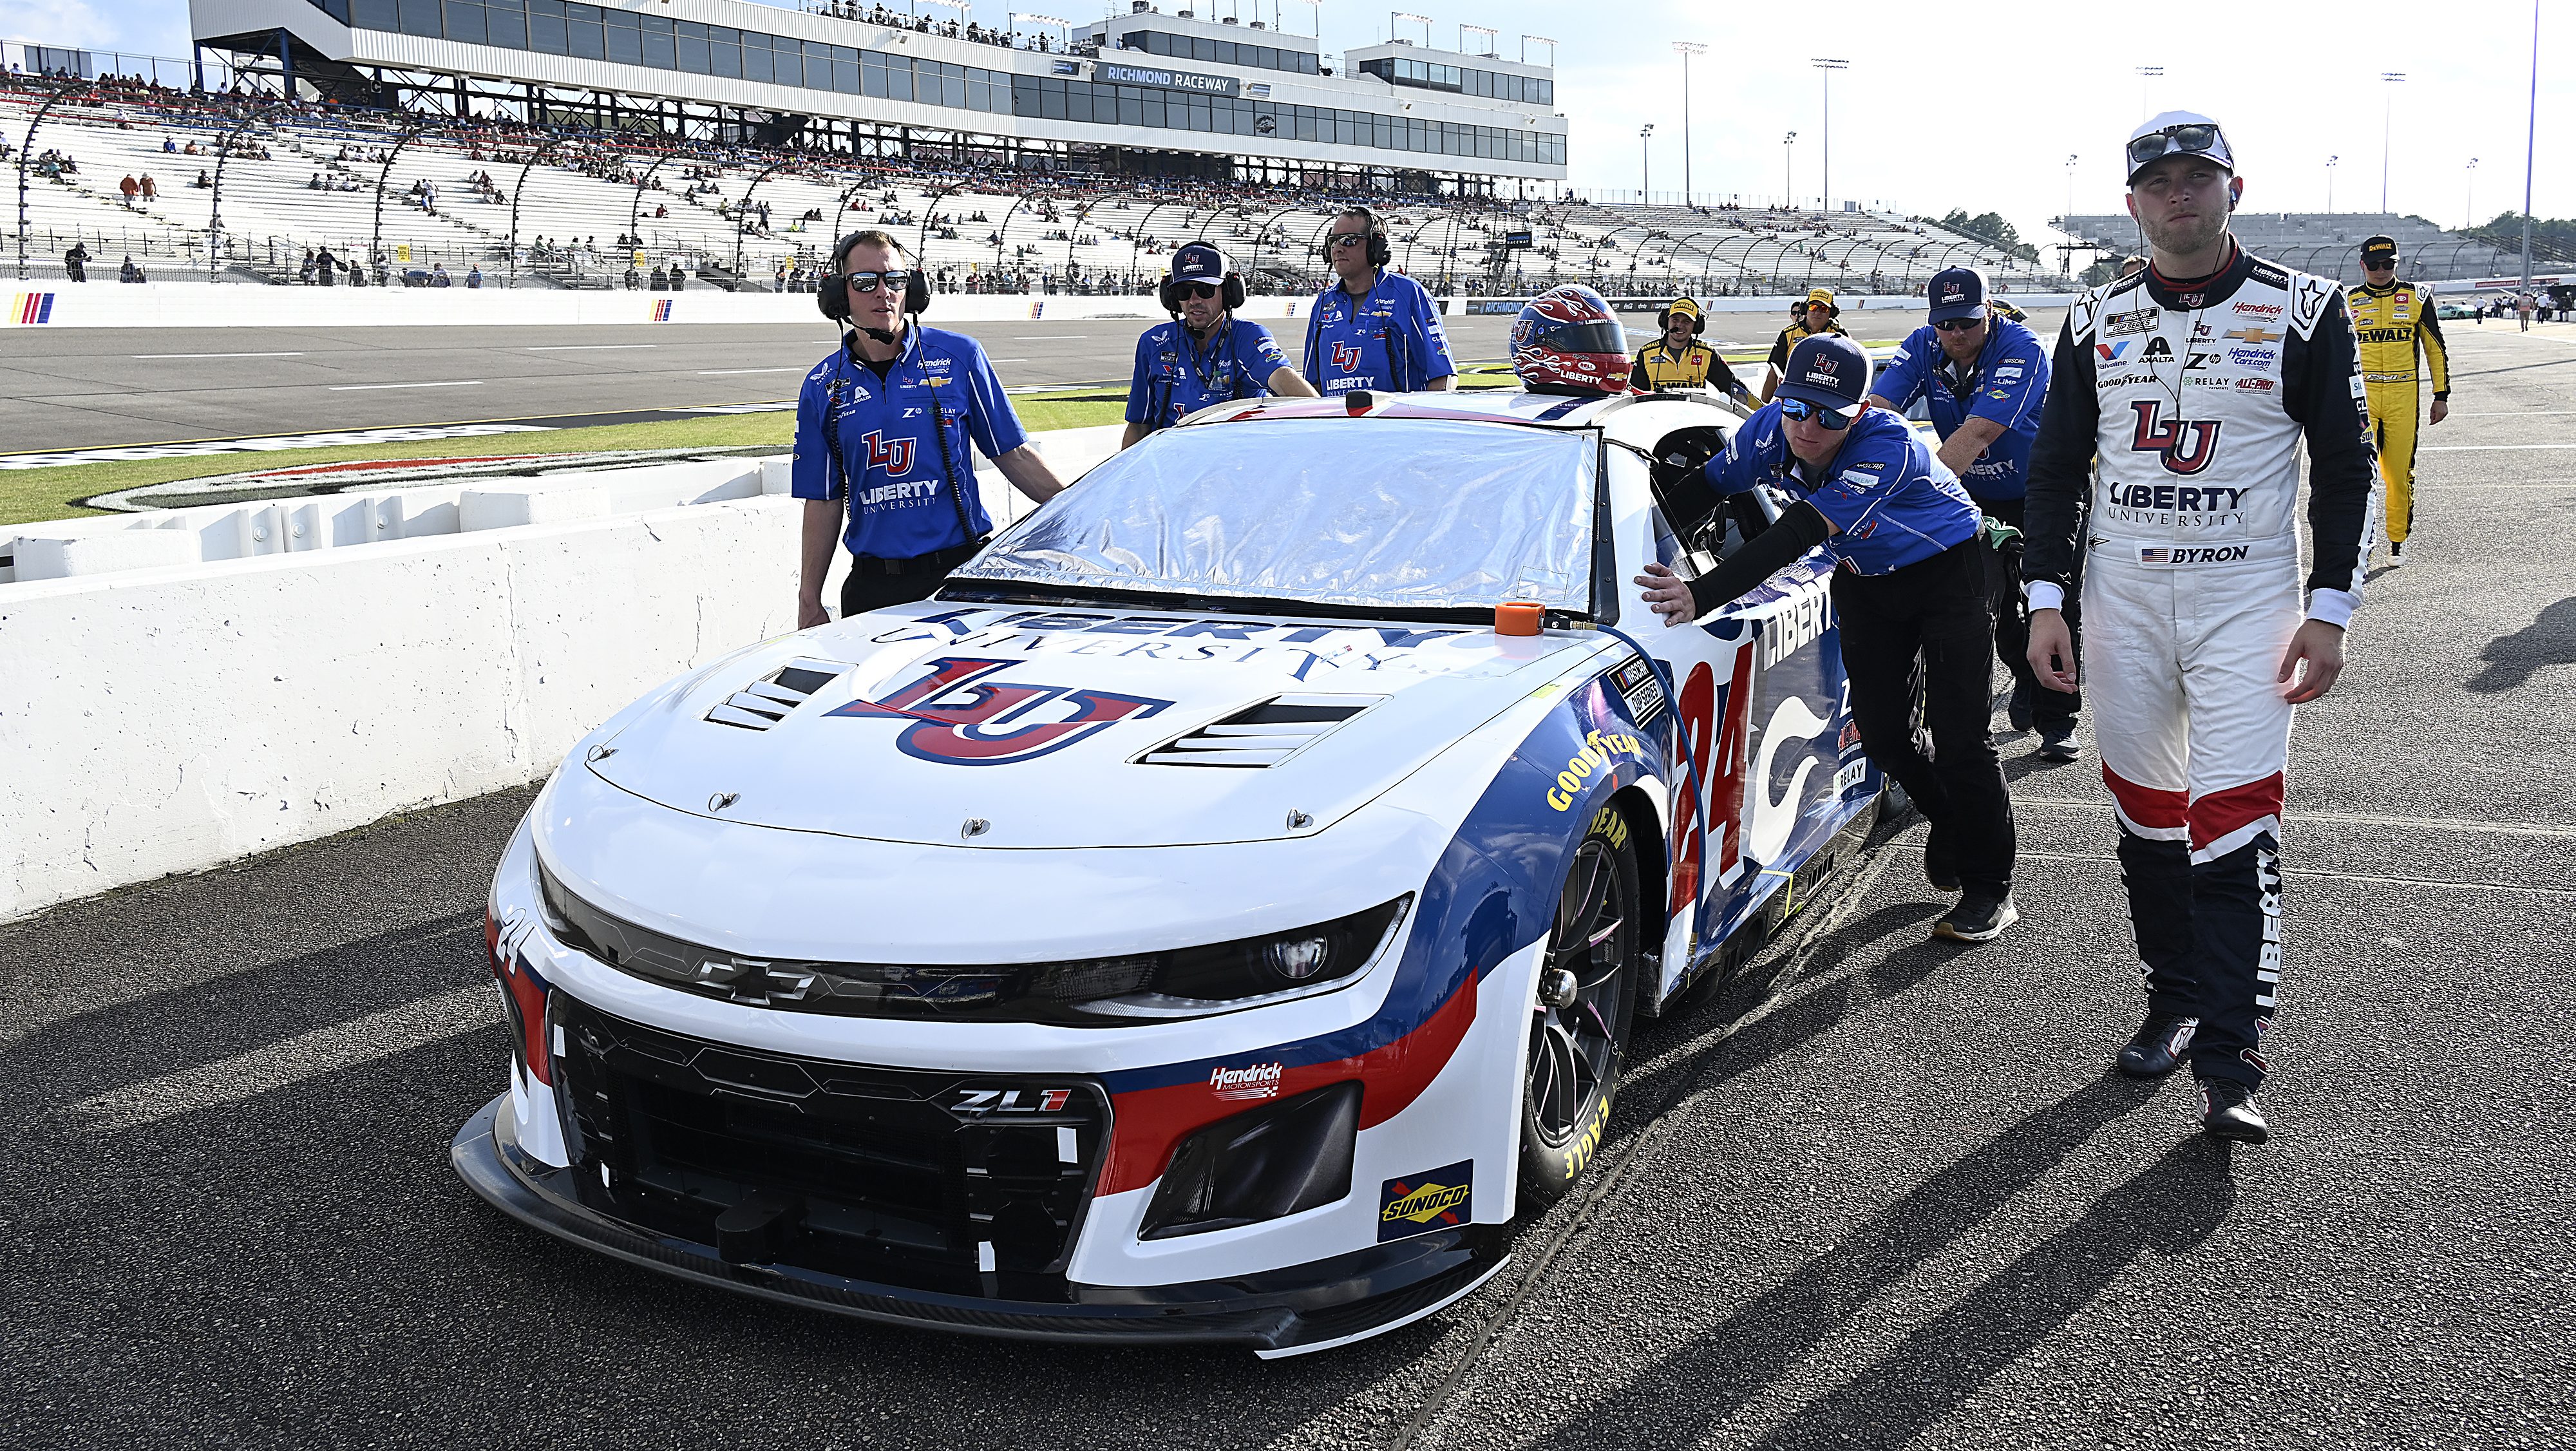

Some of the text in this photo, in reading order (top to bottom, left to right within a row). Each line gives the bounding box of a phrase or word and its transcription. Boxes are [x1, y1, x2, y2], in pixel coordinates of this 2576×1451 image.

[1108, 66, 1229, 92] RICHMOND RACEWAY
[2369, 243, 2392, 252] DEWALT
[2253, 265, 2288, 282] LIBERTY
[1486, 301, 1523, 313] RICHMOND
[2123, 310, 2150, 322] NASCAR
[2231, 301, 2284, 314] Hendrick
[2113, 319, 2151, 332] CUP SERIES
[2357, 329, 2412, 342] DEWALT
[1331, 341, 1361, 373] LU
[2183, 353, 2221, 370] Z hp
[2228, 347, 2277, 360] Hendrick
[2234, 357, 2271, 366] Cars.com
[1814, 353, 1839, 375] LU
[1326, 376, 1375, 390] LIBERTY
[1560, 370, 1602, 385] LIBERTY
[1806, 371, 1840, 384] LIBERTY
[1806, 377, 1839, 388] UNIVERSITY
[2098, 374, 2158, 389] GOODYEAR
[2195, 377, 2230, 386] RELAY
[2235, 378, 2275, 390] ALL-PRO
[853, 395, 872, 404] AXALTA
[2130, 399, 2224, 476] LU
[861, 429, 917, 477] LU
[1966, 459, 2014, 475] BERTY
[1844, 474, 1875, 485] SIEMENS
[859, 479, 939, 506] LIBERTY
[2110, 482, 2250, 511] LIBERTY
[863, 496, 938, 515] UNIVERSITY
[2108, 506, 2246, 527] UNIVERSITY
[2170, 545, 2249, 564] BYRON
[1763, 569, 1840, 672] LIBERT
[1624, 659, 1649, 685] NASCAR
[1631, 681, 1658, 713] CUP SERIES
[819, 657, 1177, 766] LU
[1547, 728, 1644, 811] GOODYEAR
[1840, 763, 1864, 790] RELAY
[1671, 639, 1756, 920] 24
[2255, 848, 2282, 1009] LIBERTY
[1209, 1062, 1283, 1090] Hendrick
[1222, 1079, 1280, 1090] MOTORSPORTS
[951, 1089, 1072, 1112] ZL1
[1563, 1094, 1609, 1180] EAGLE
[1385, 1187, 1467, 1219] SUNOCO
